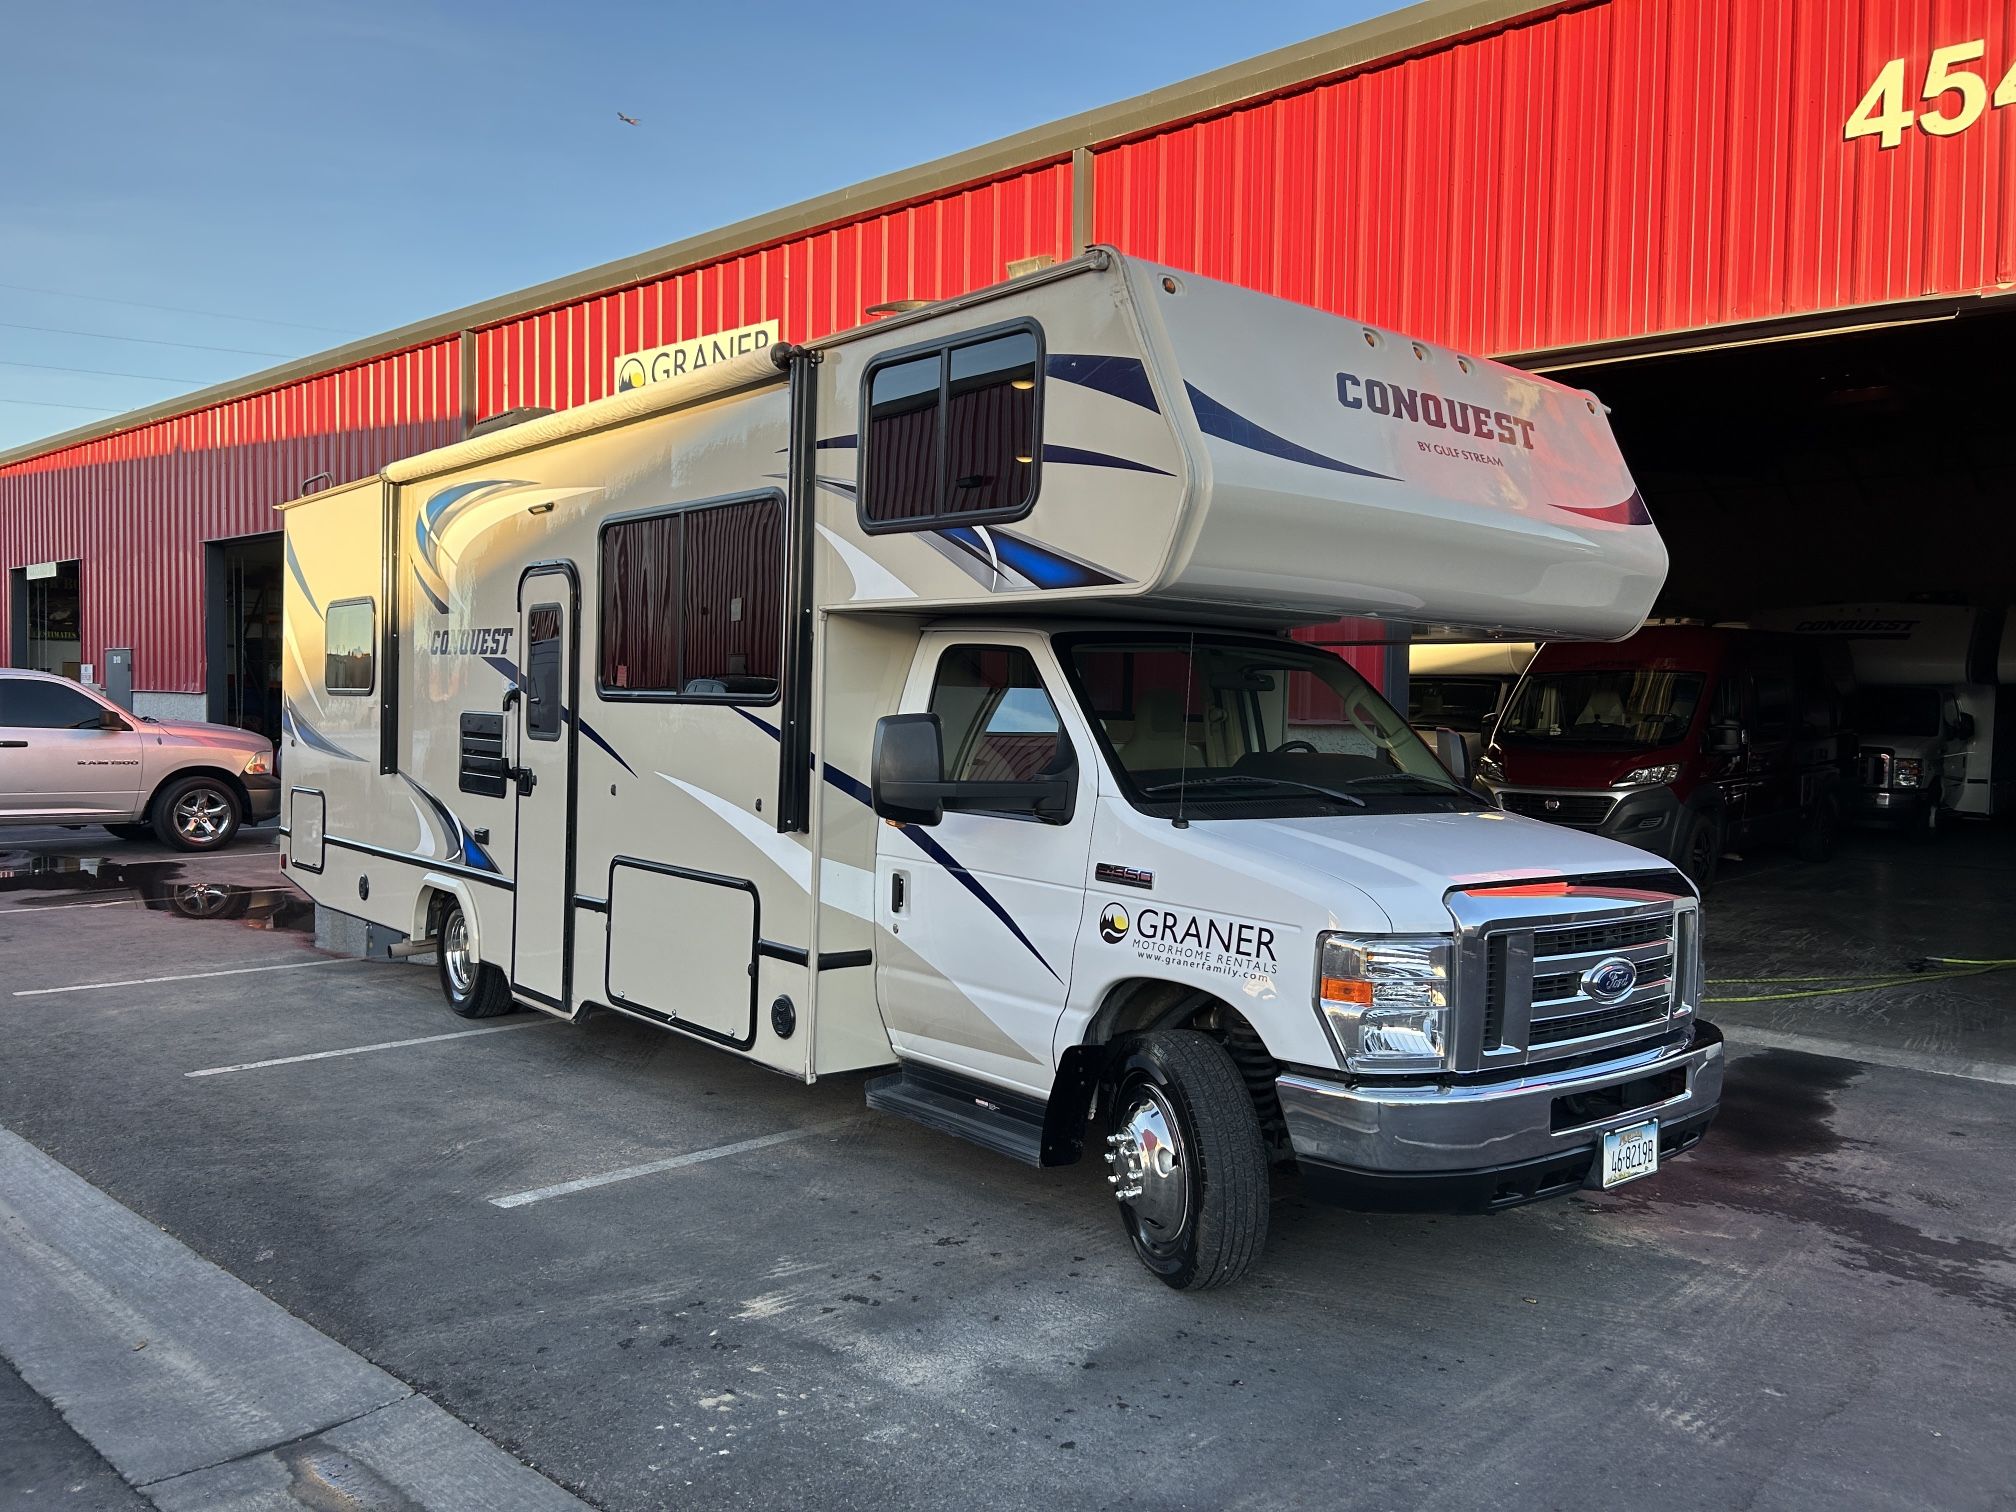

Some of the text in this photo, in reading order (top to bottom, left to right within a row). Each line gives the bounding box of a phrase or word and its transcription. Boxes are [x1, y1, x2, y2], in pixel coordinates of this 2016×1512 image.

[1336, 372, 1535, 450] CONQUEST
[1417, 440, 1504, 467] BY GULF STREAM
[430, 627, 514, 655] CONQUEST
[1795, 620, 1920, 632] CONQUEST
[1137, 908, 1277, 962] GRANER
[1132, 938, 1278, 974] MOTORHOME RENTALS
[1137, 951, 1269, 983] www.granerfamily.com
[1606, 970, 1629, 990] Ford
[1611, 1139, 1654, 1174] 46-8219B
